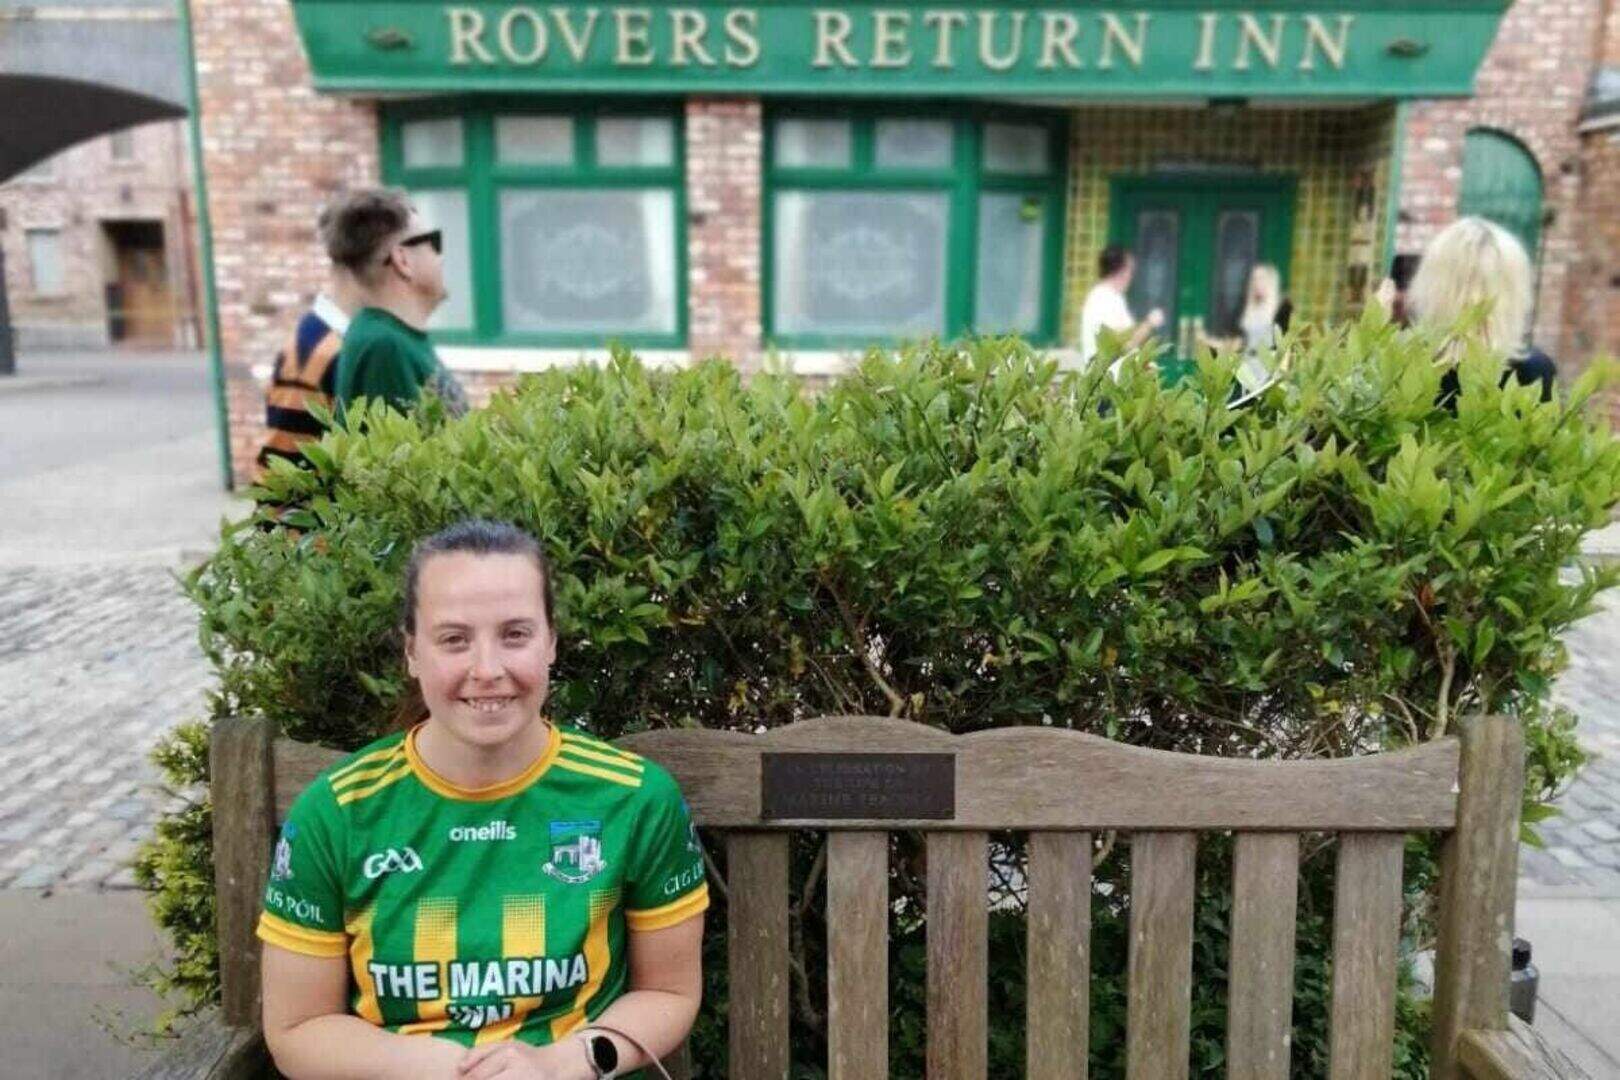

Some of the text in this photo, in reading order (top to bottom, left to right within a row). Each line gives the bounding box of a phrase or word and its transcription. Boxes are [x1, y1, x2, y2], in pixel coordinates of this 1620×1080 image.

[446, 7, 1355, 71] ROVERS RETURN INN
[363, 846, 424, 879] GAA
[369, 953, 588, 999] THE MARINA
